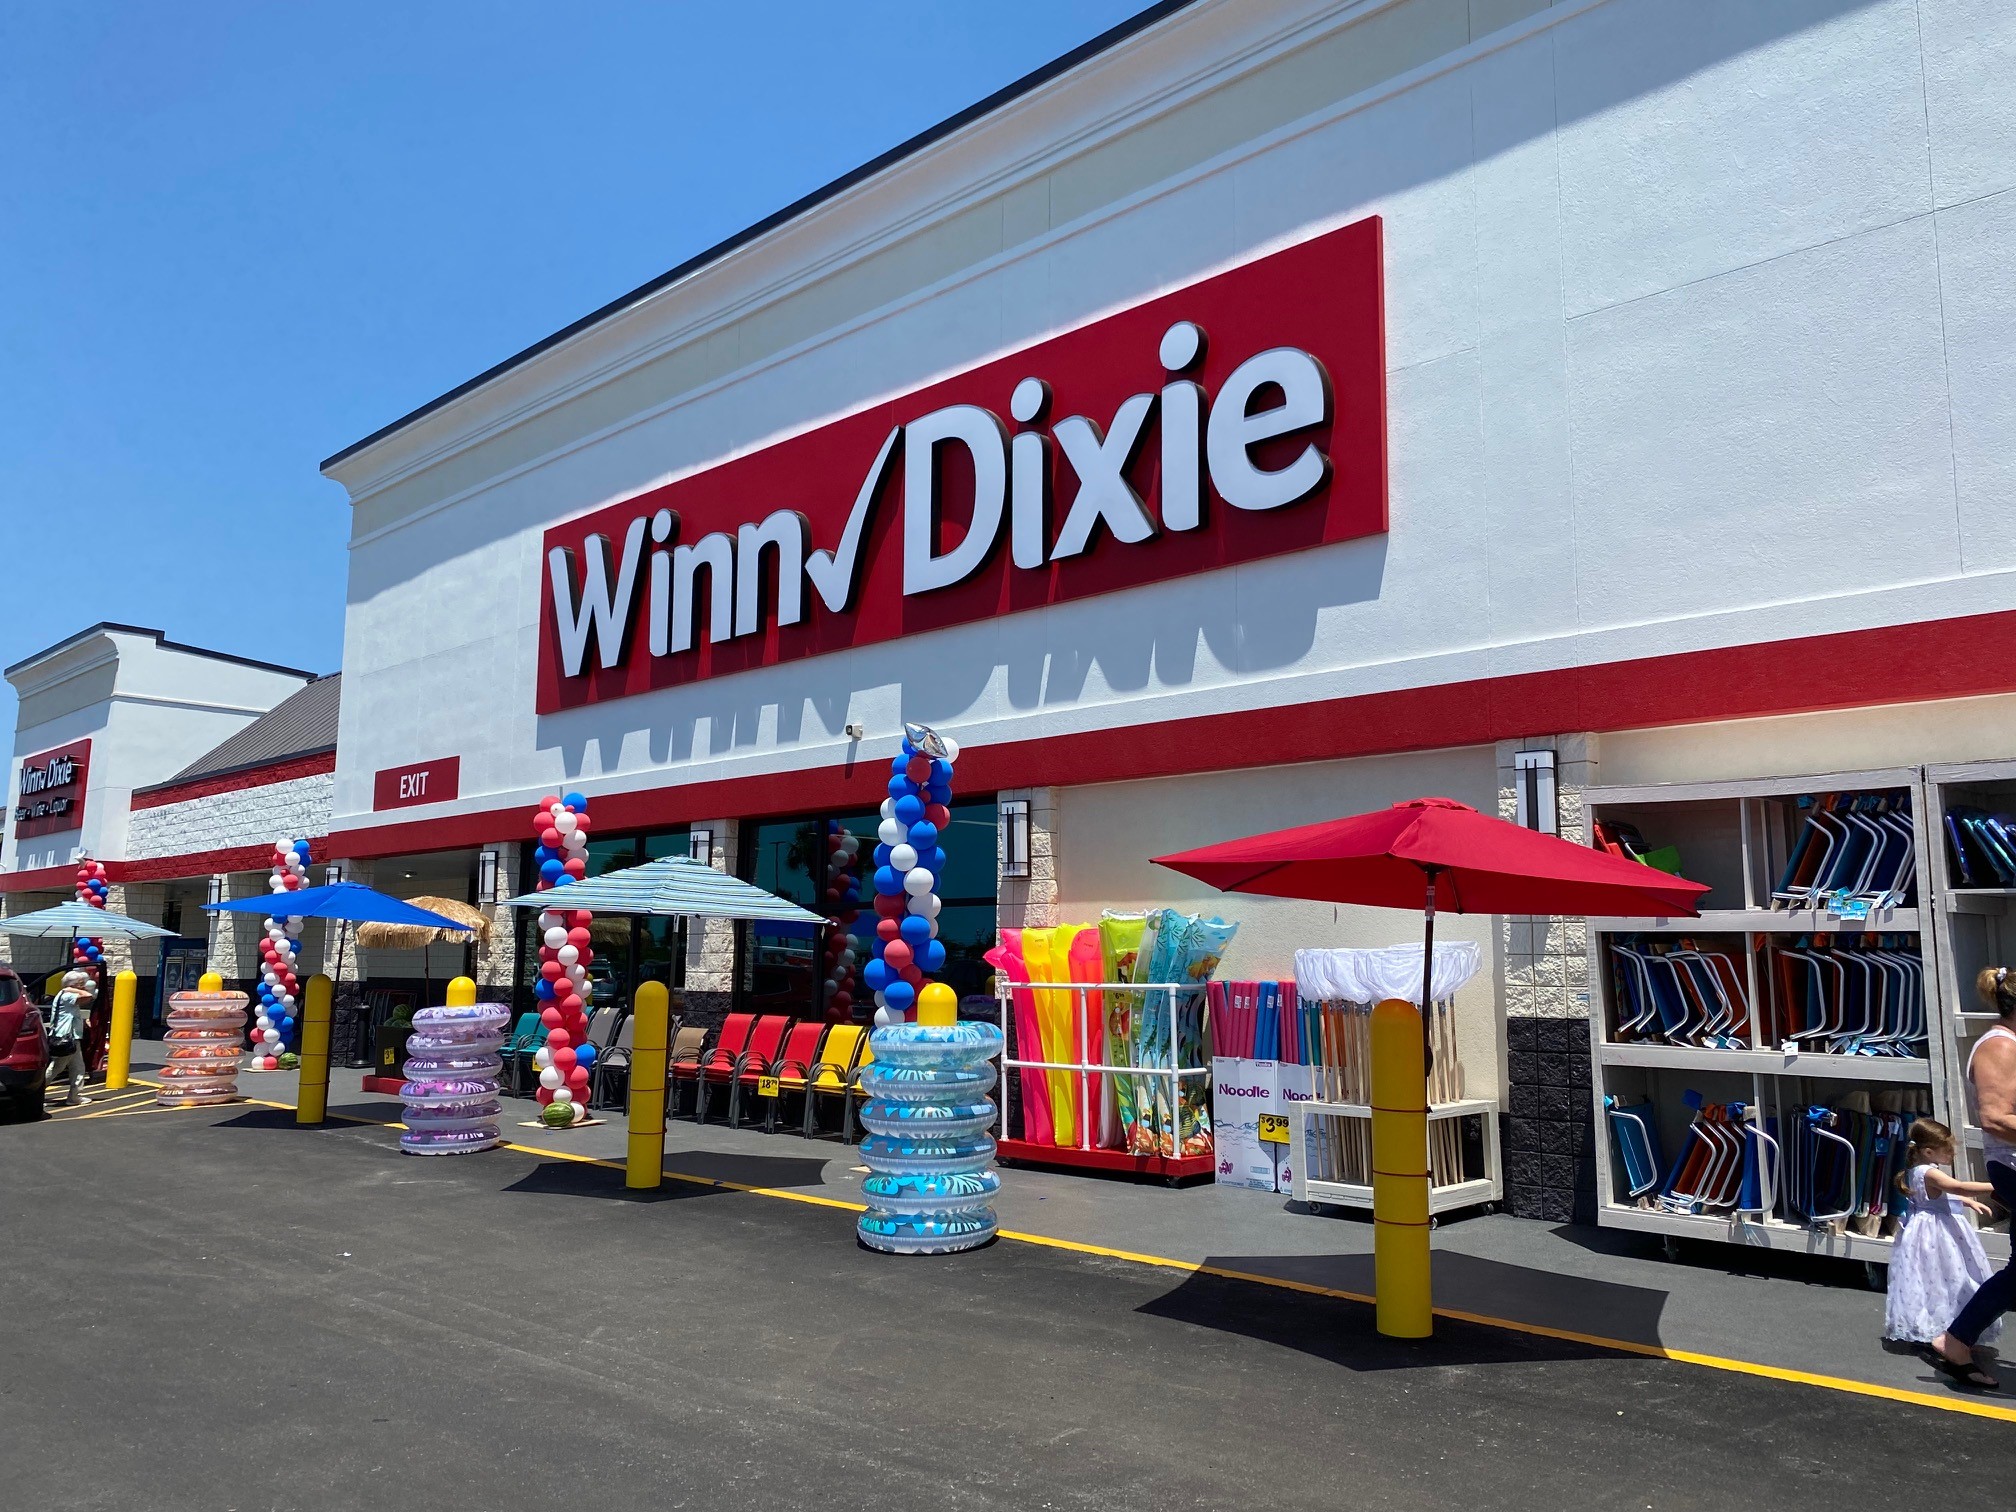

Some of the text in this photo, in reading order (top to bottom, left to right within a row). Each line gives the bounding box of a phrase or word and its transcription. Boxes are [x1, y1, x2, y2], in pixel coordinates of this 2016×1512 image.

[548, 320, 1330, 678] Winn Dixie
[19, 754, 72, 795] Winn Dixie
[400, 771, 430, 799] EXIT
[1219, 1083, 1270, 1099] Noodle
[1282, 1088, 1325, 1102] Noo
